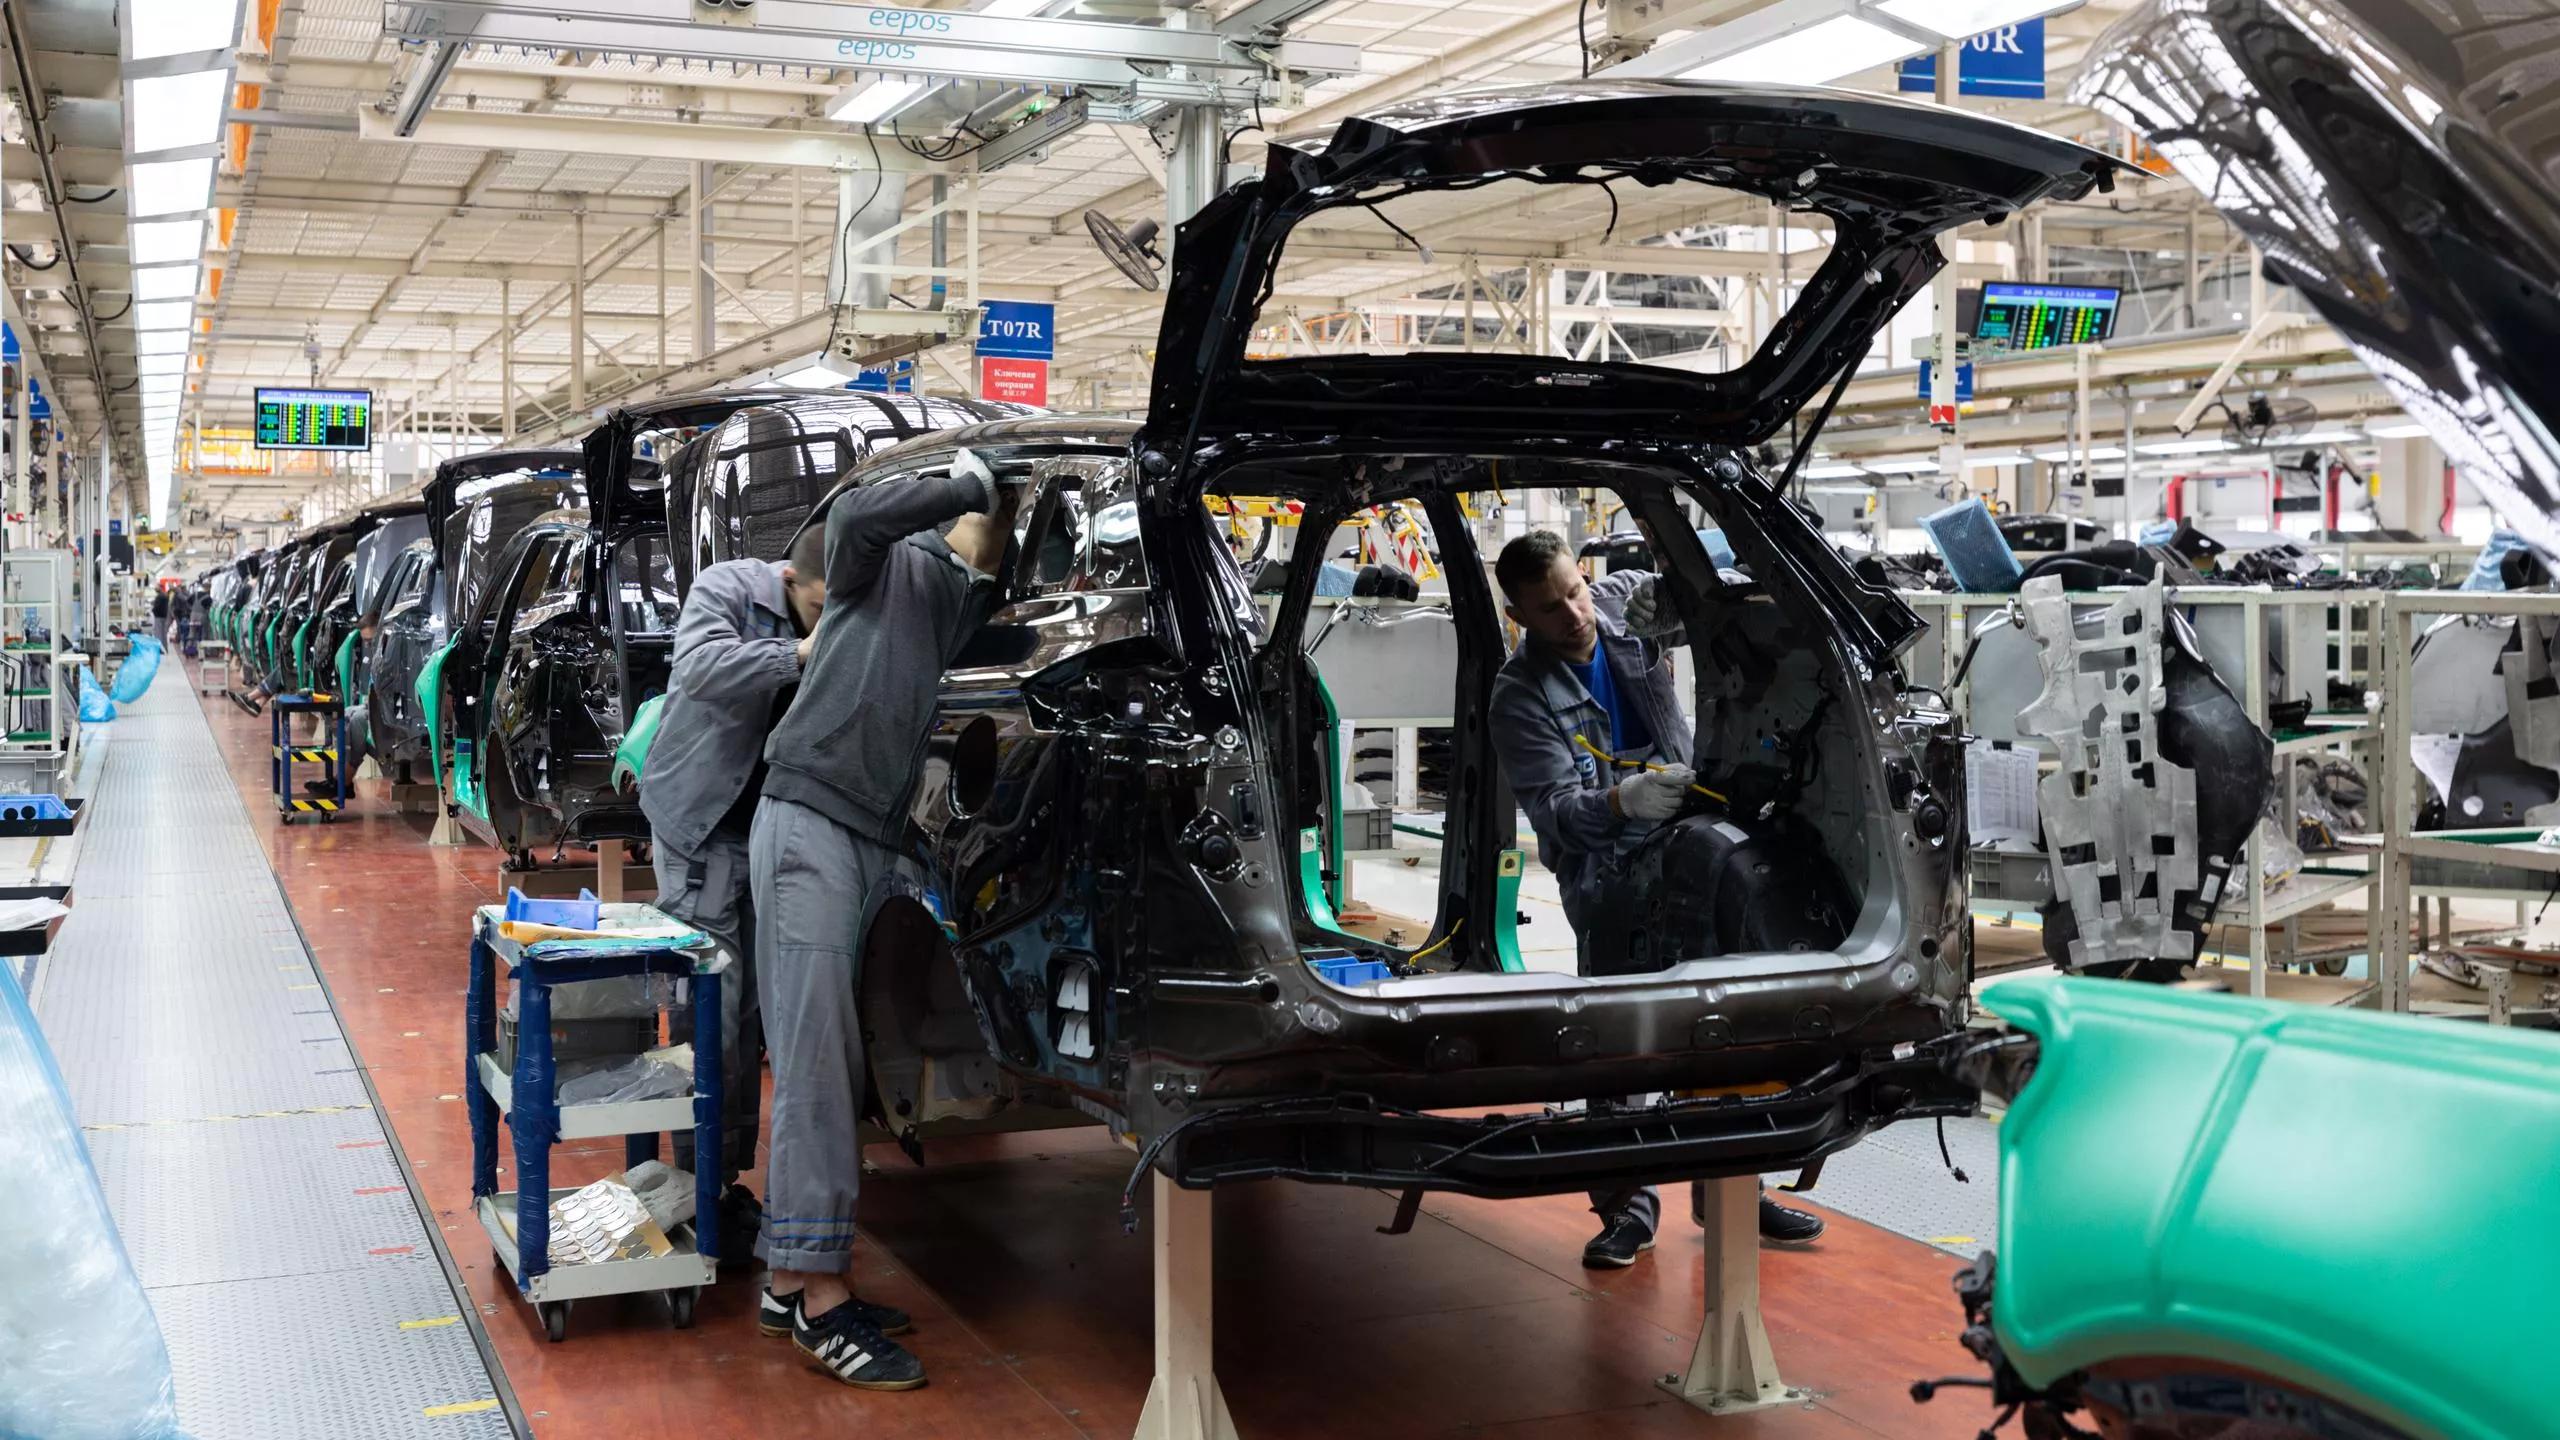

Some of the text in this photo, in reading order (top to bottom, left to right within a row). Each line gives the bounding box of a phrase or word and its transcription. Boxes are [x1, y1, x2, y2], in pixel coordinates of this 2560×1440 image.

[869, 9, 951, 35] eepos
[838, 39, 917, 64] eepos
[988, 319, 1043, 339] T07R
